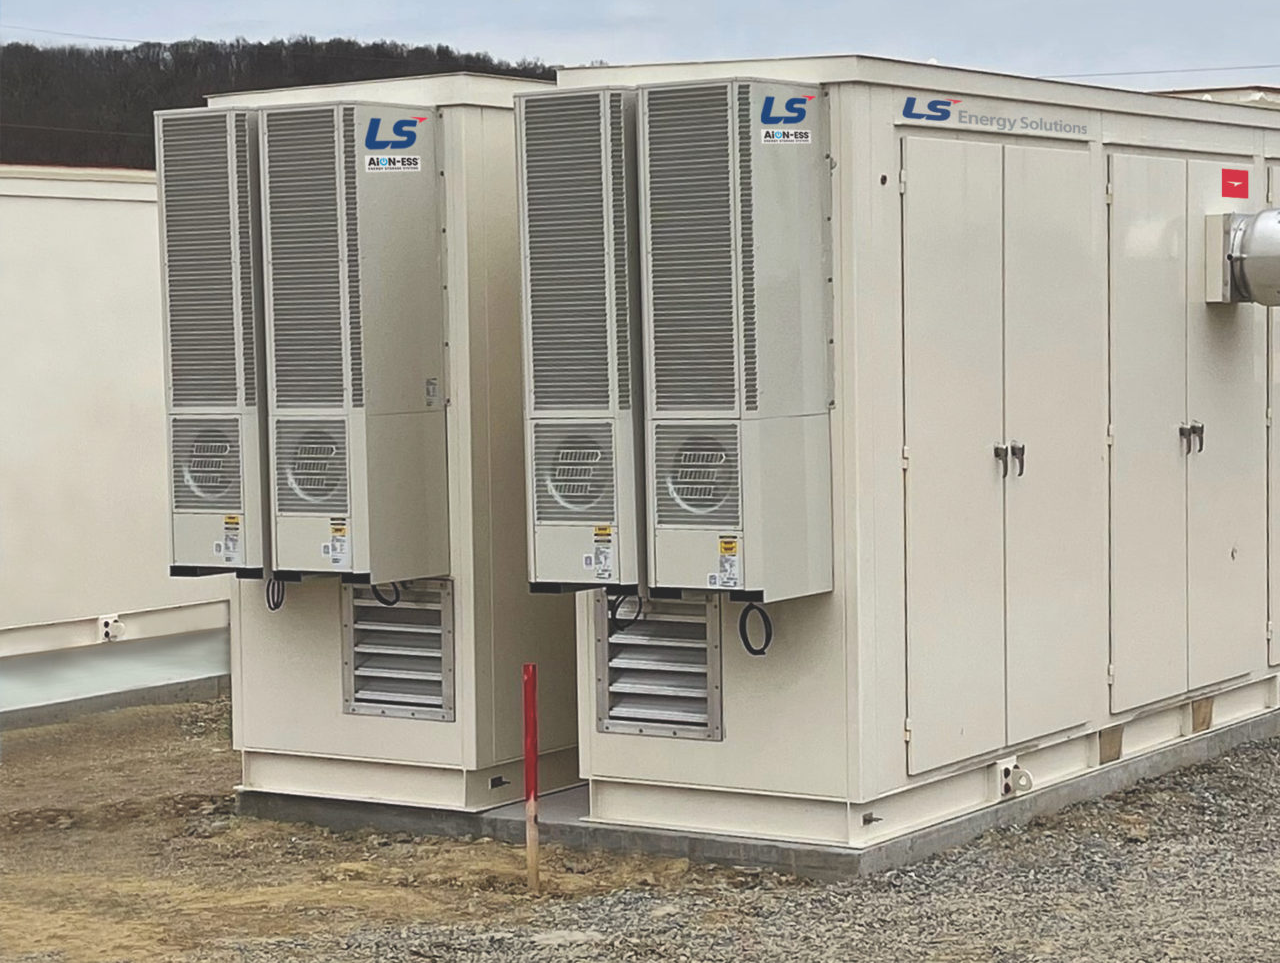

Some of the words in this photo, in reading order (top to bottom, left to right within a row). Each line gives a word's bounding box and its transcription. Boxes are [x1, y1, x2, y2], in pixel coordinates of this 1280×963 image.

[761, 96, 807, 125] LS
[902, 97, 951, 121] LS
[958, 110, 1017, 131] Energy
[1020, 117, 1087, 135] Solutions
[365, 118, 418, 150] LS
